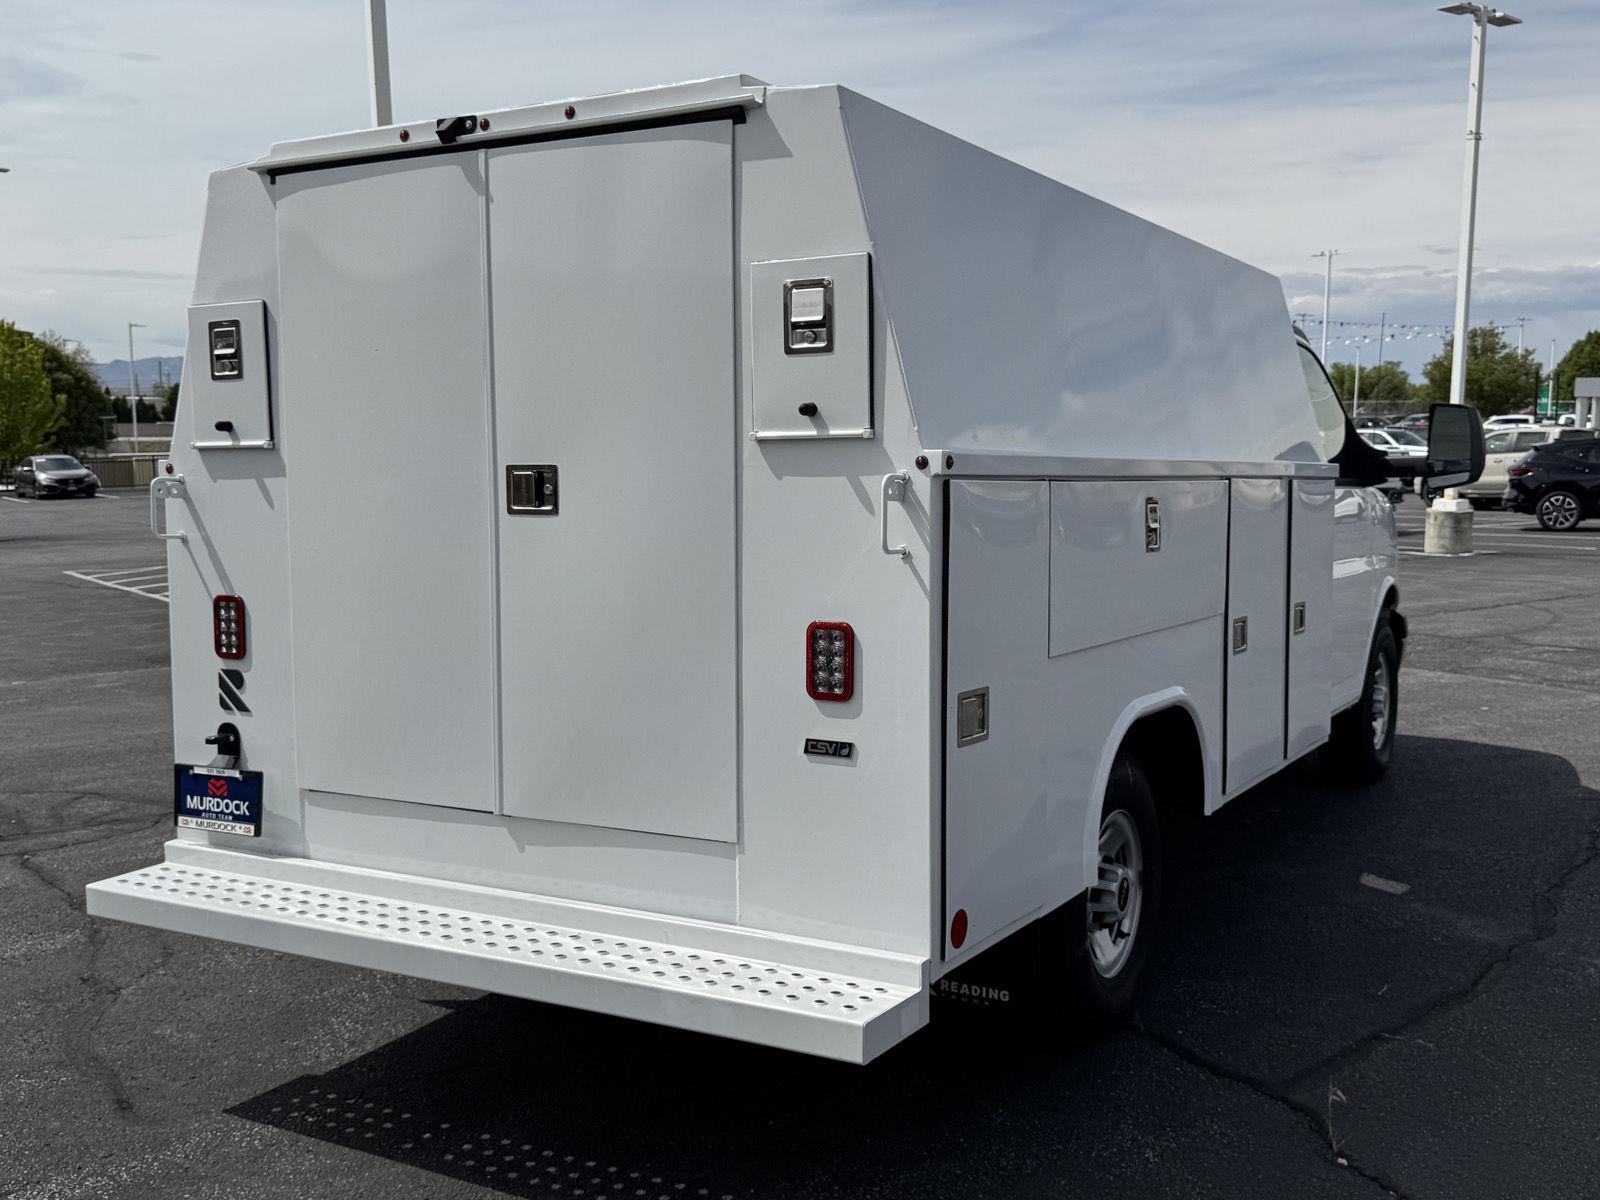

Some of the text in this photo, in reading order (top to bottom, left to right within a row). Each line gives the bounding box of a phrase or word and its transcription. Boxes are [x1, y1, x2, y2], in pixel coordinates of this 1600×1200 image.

[807, 740, 837, 755] CSV
[186, 794, 250, 816] MURDOCK
[218, 813, 233, 821] TEAM
[195, 820, 237, 832] MURDOCK
[940, 980, 1010, 1002] READING
